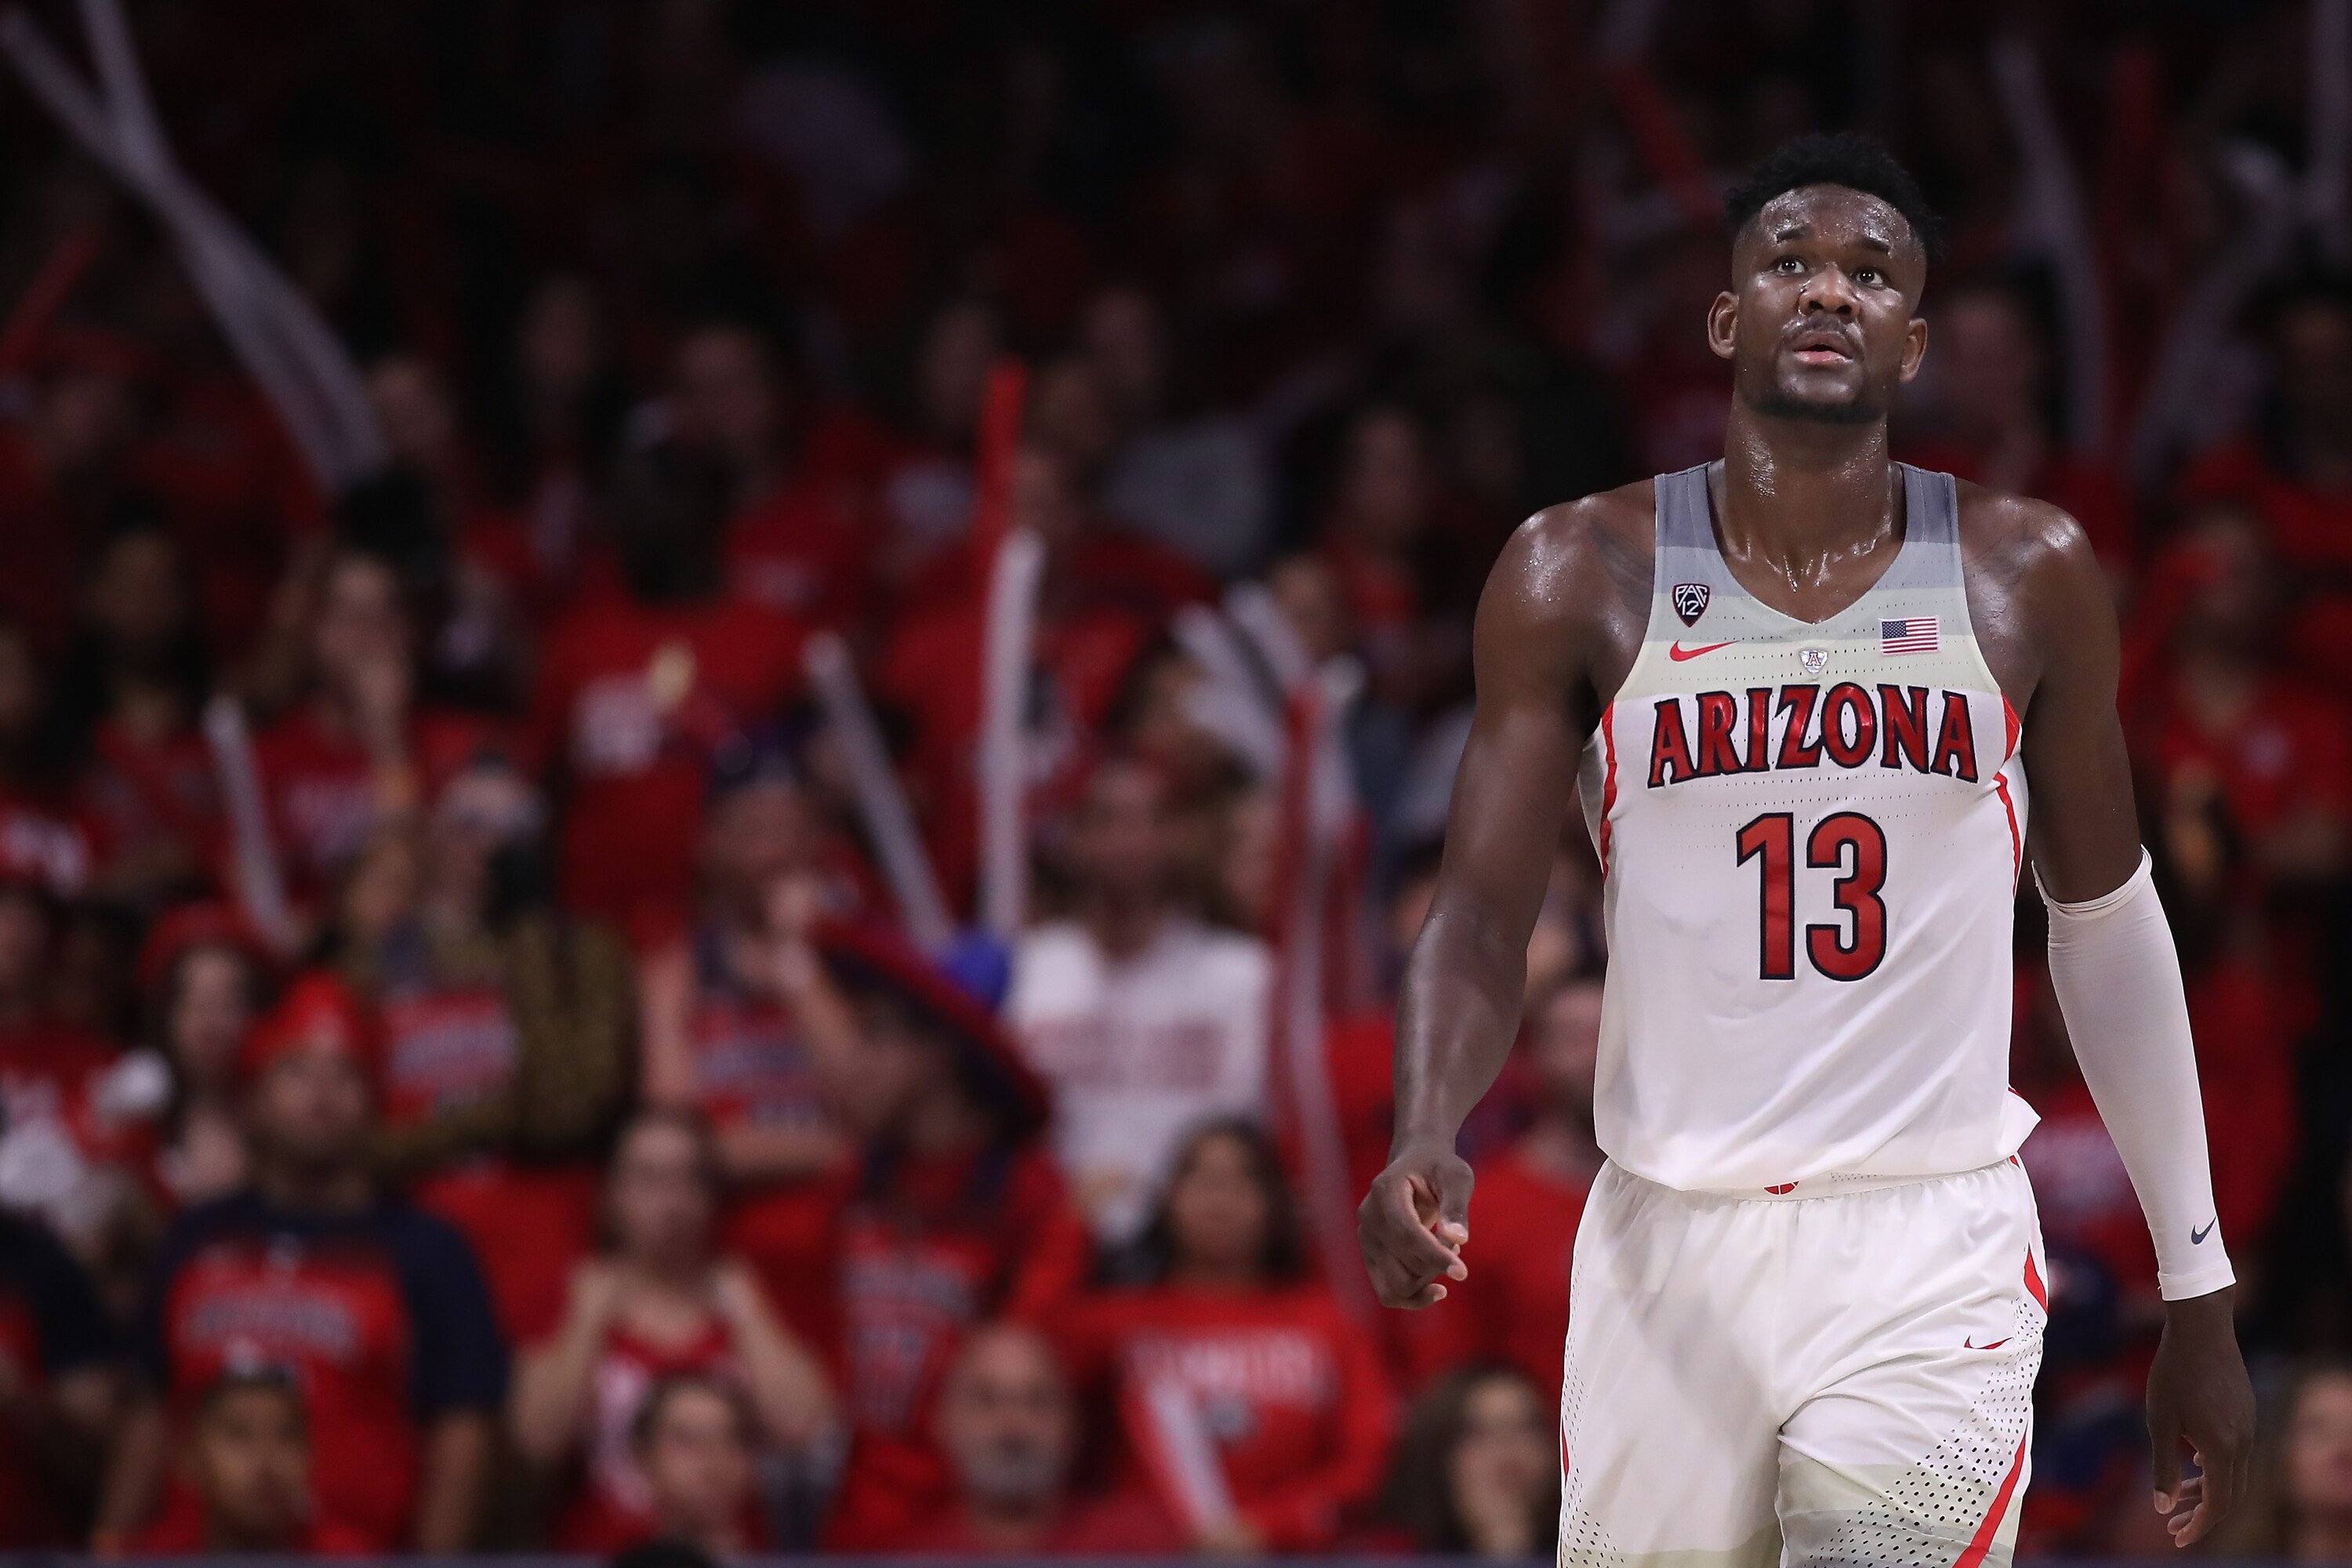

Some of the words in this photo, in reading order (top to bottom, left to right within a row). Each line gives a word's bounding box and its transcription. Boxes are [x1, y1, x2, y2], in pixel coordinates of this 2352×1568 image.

[1675, 585, 1708, 608] PAC
[1682, 601, 1699, 615] 12
[1806, 652, 1820, 666] A
[1647, 681, 1979, 789] ARIZONA
[1736, 811, 1887, 982] 13
